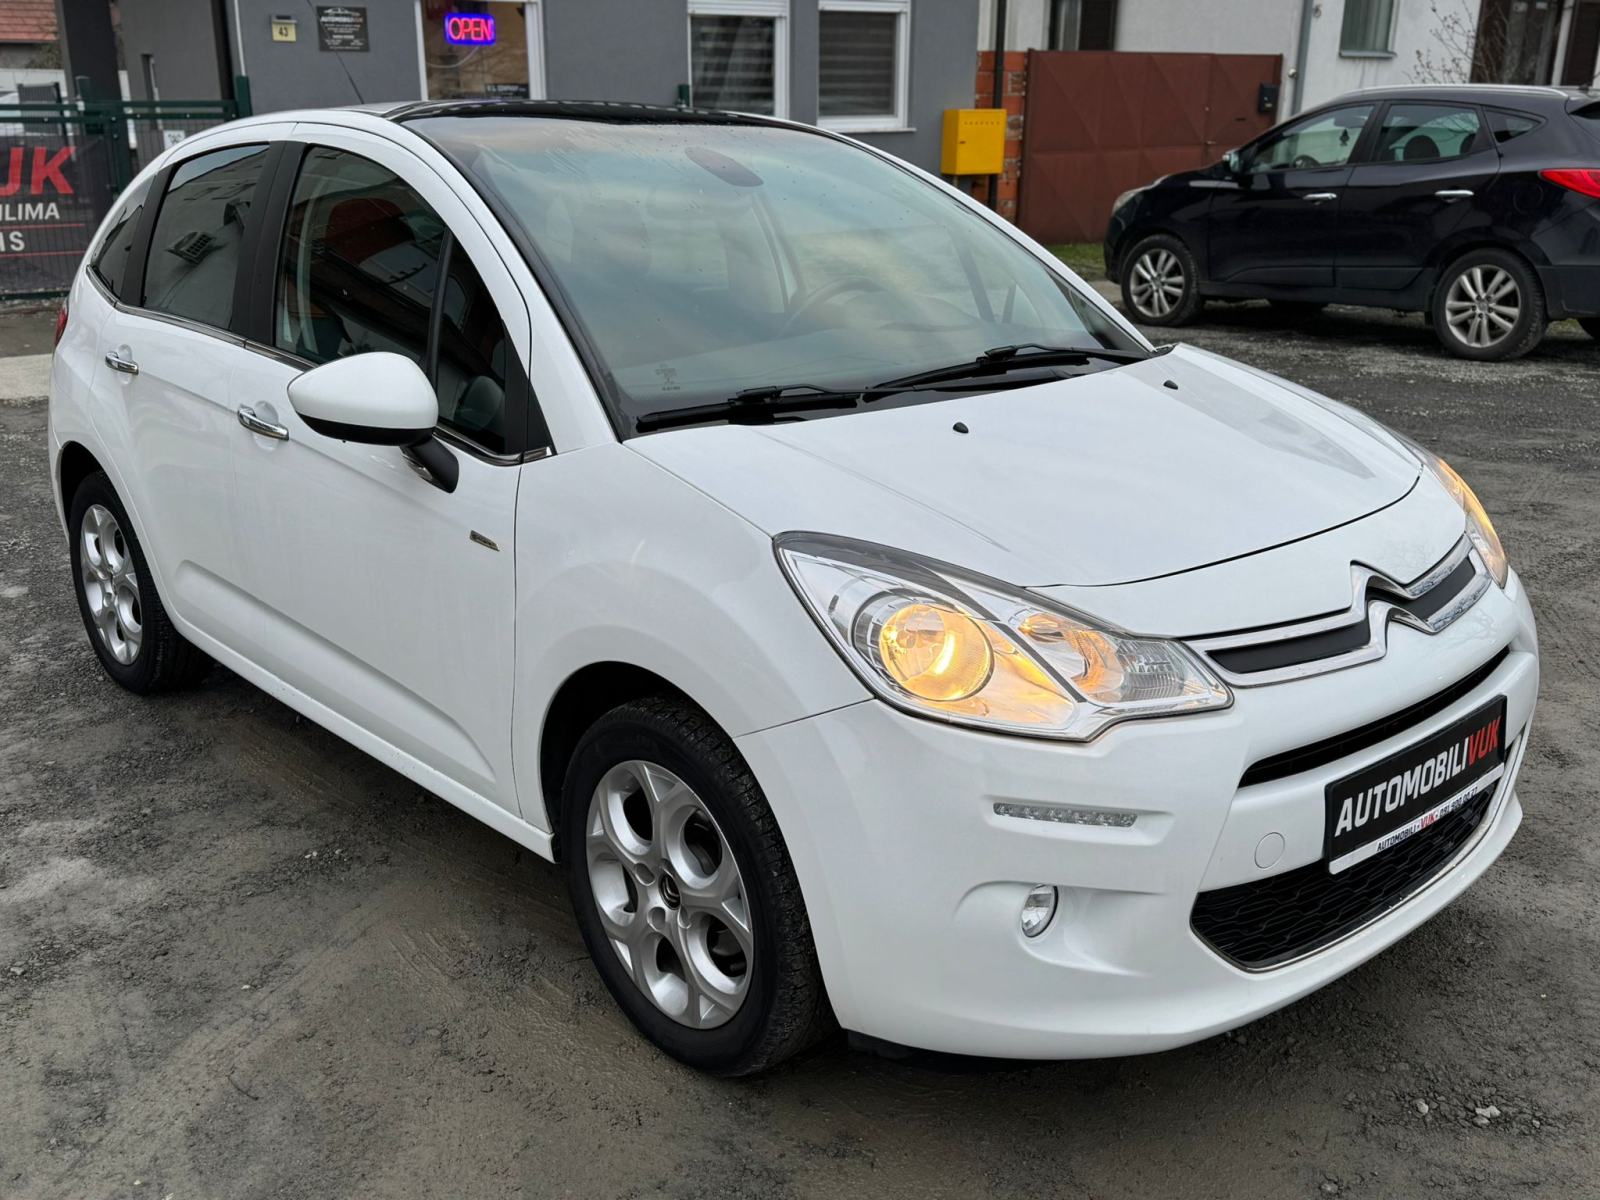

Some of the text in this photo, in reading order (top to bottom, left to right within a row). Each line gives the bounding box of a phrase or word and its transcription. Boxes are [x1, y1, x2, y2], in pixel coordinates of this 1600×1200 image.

[278, 26, 289, 37] 43
[448, 17, 493, 40] OPEN
[1377, 824, 1417, 852] AUTOMOBILI
[1420, 811, 1437, 829] VUK
